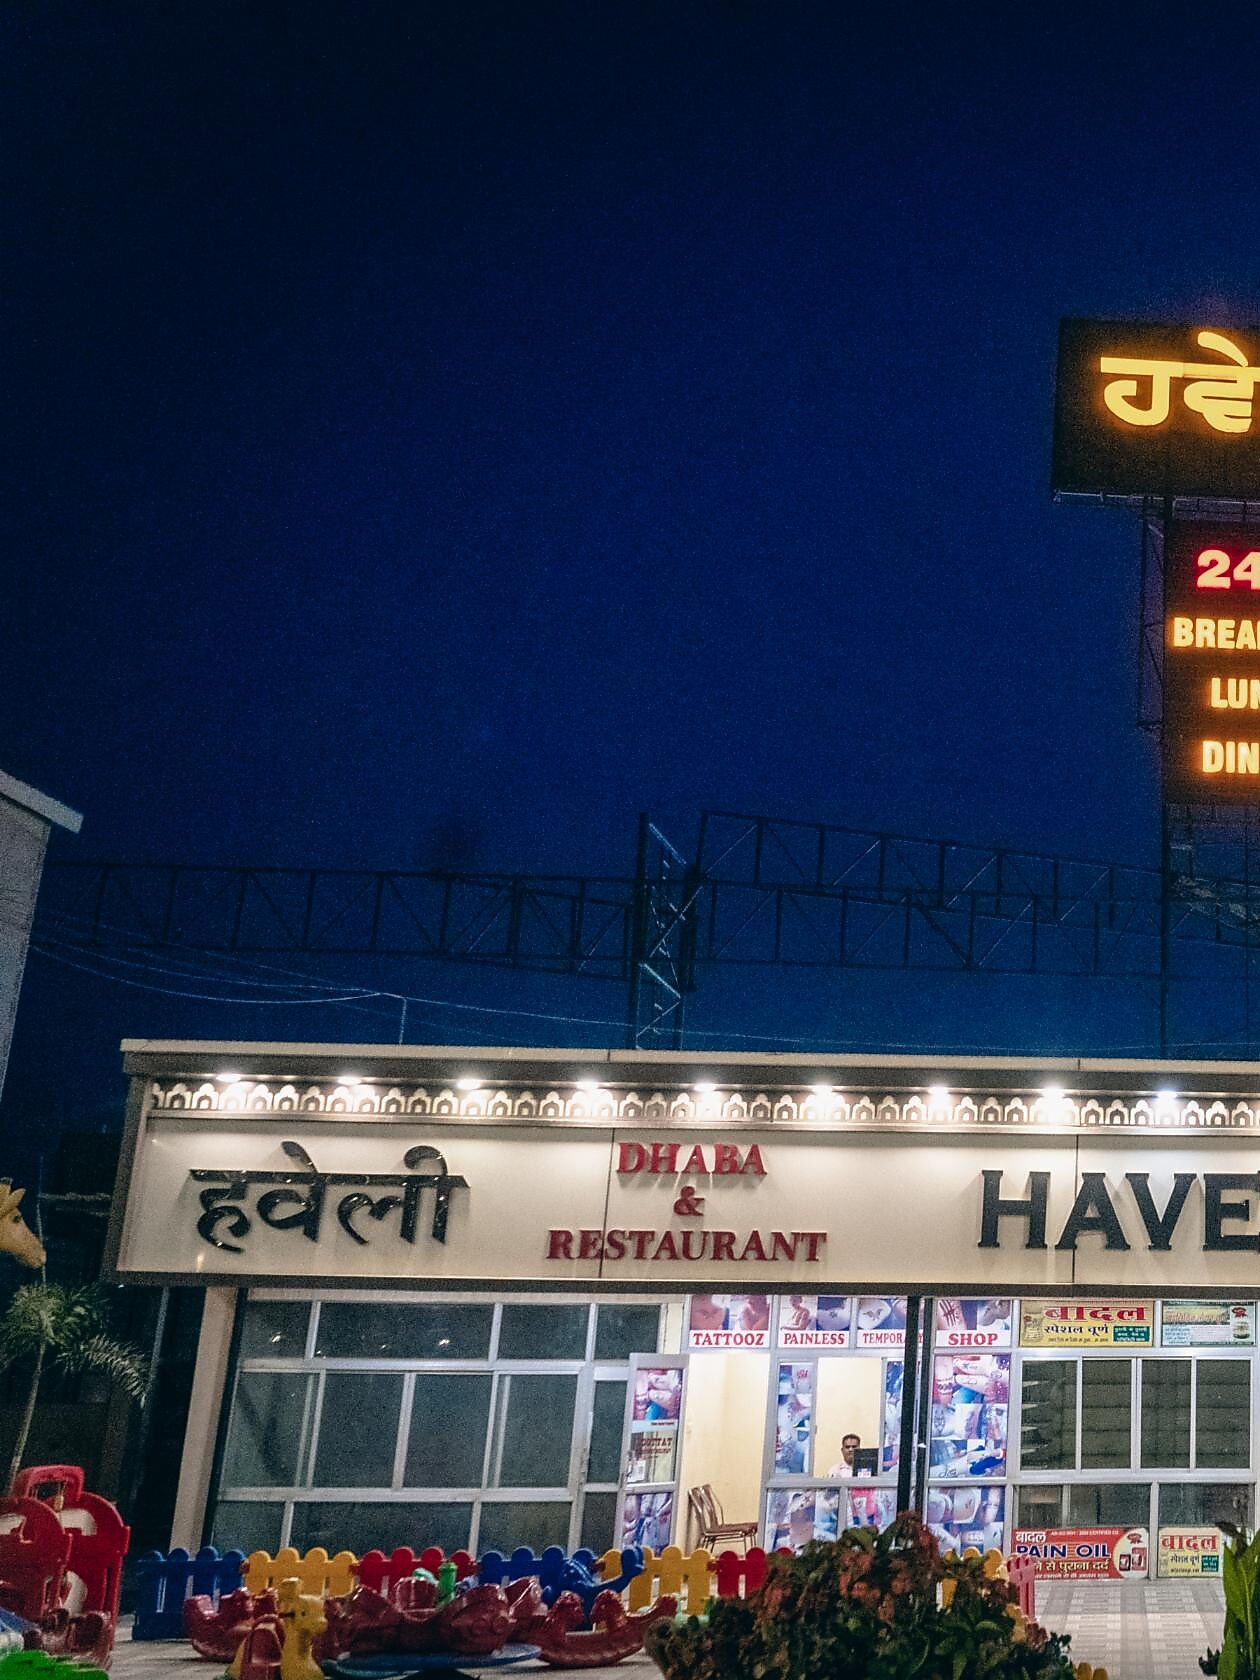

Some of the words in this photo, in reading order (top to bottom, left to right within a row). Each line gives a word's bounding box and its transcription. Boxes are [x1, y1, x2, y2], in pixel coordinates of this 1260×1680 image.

[616, 1142, 768, 1176] DHABA
[188, 1141, 471, 1254] हवेली
[673, 1186, 705, 1218] &
[545, 1229, 827, 1263] RESTAURANT
[693, 1332, 764, 1346] TATTOOZ
[783, 1332, 845, 1345] PAINLESS
[863, 1332, 924, 1344] TEMPORY
[948, 1332, 998, 1346] SHOP
[1016, 1544, 1067, 1558] PAIN
[1076, 1544, 1112, 1559] OIL
